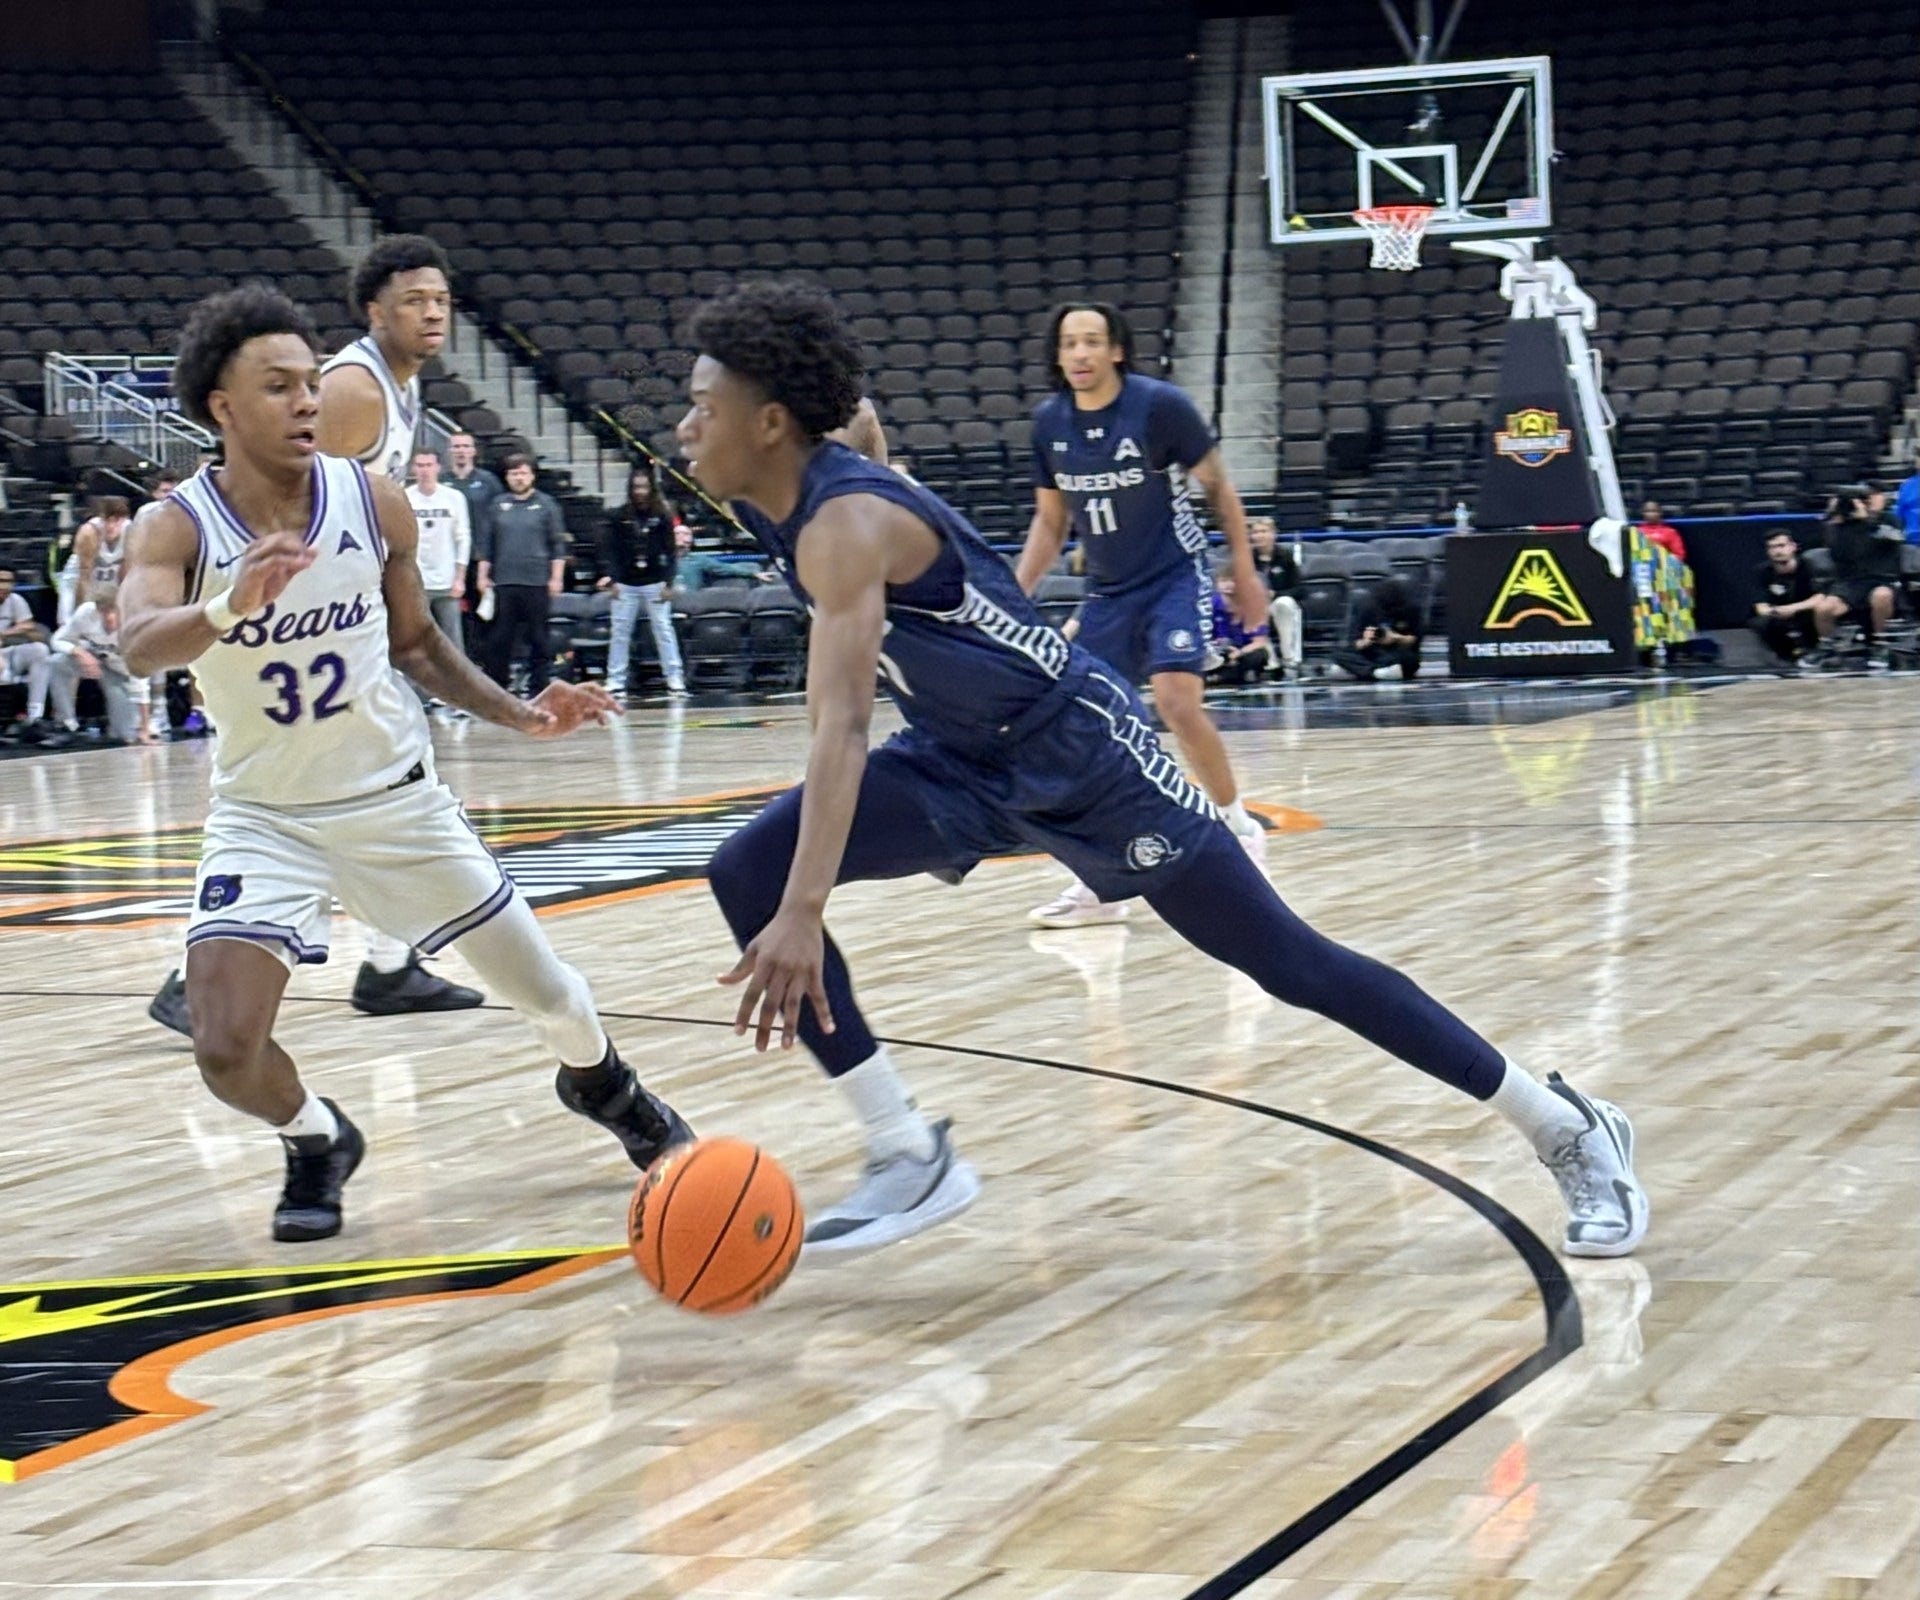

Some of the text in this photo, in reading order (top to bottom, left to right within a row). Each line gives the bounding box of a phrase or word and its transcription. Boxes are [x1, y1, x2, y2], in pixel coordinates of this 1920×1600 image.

[1054, 467, 1145, 492] QUEENS
[1084, 497, 1118, 535] 11
[219, 592, 371, 648] Bears
[1464, 642, 1499, 657] THE
[259, 651, 352, 726] 32
